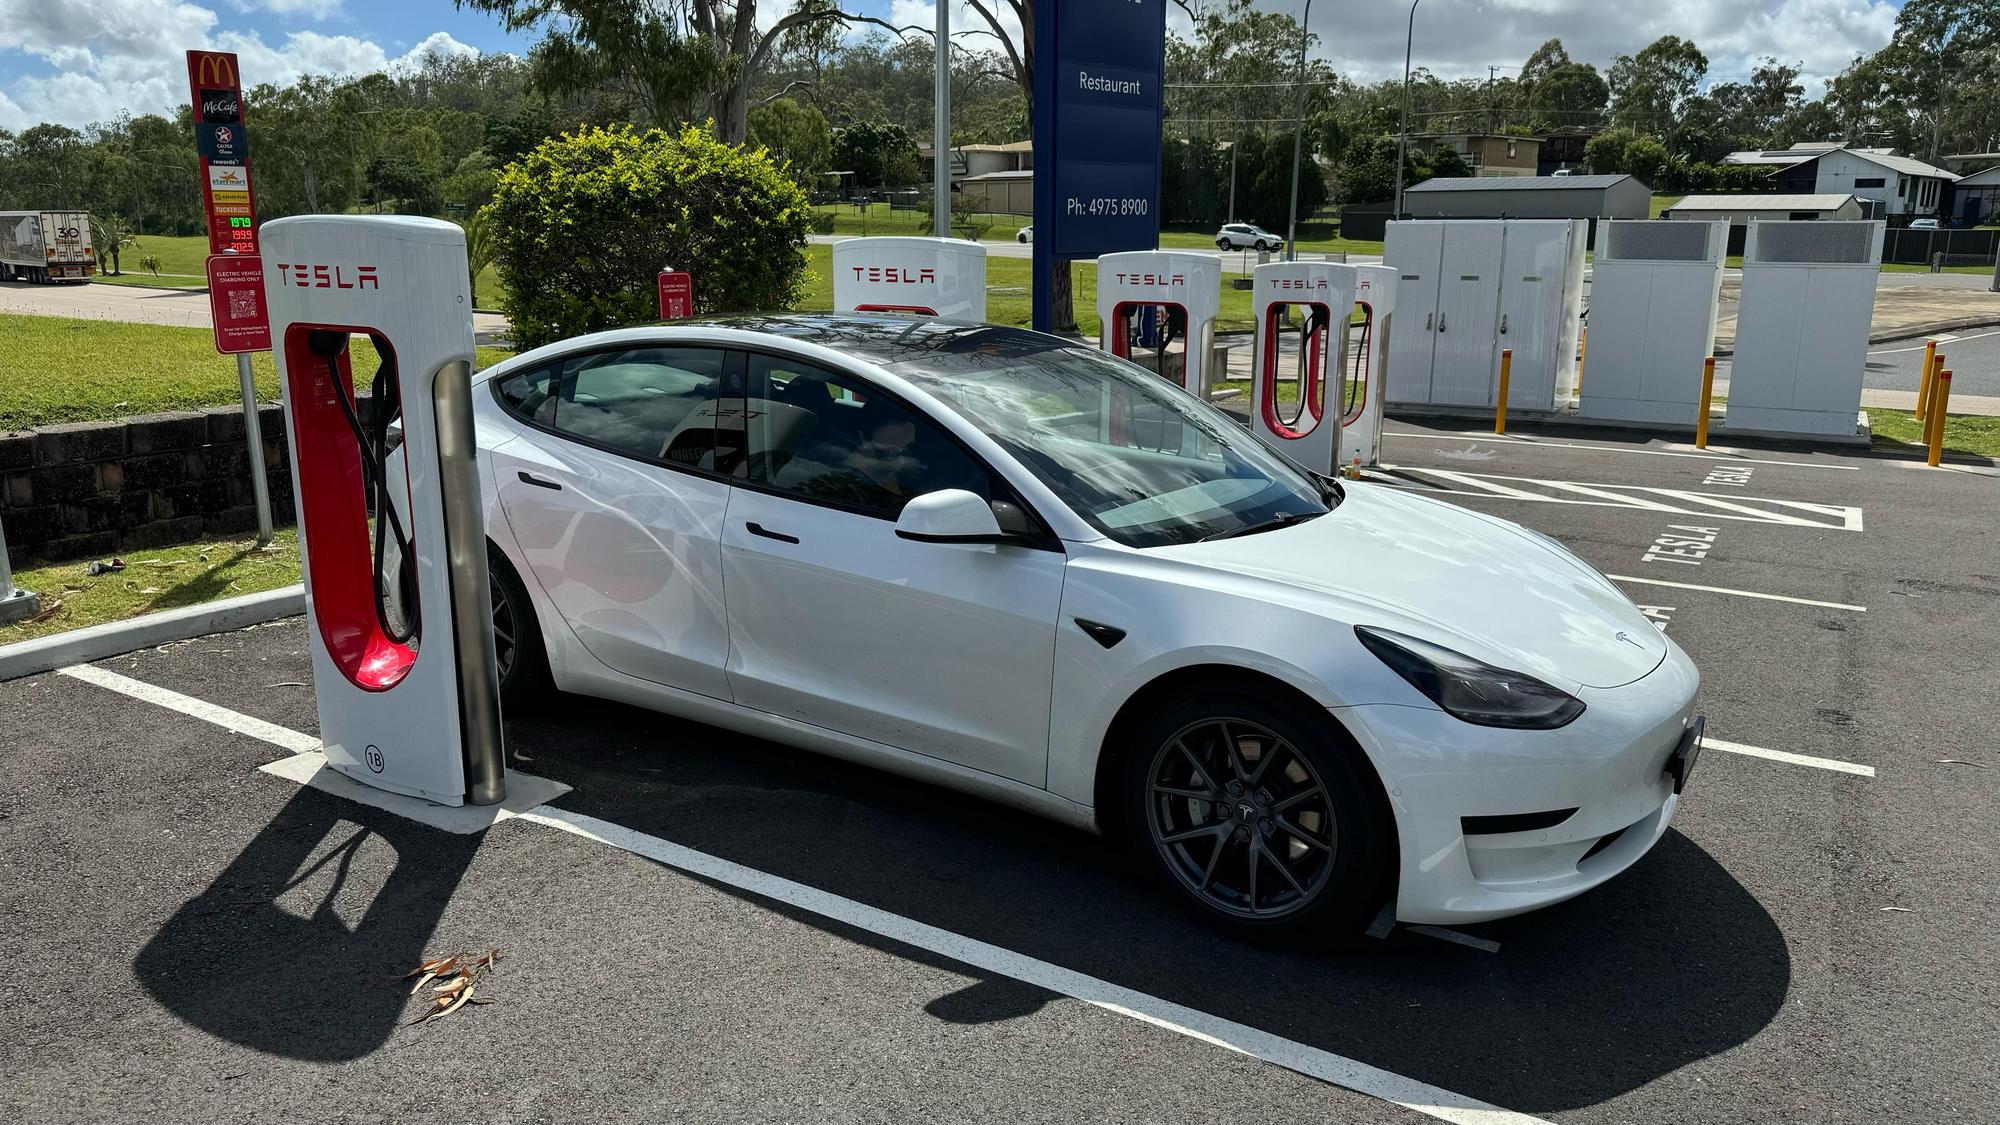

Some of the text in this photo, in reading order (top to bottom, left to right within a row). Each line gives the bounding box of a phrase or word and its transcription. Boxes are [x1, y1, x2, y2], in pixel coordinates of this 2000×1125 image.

[1080, 71, 1141, 95] Restaurant
[1067, 198, 1148, 216] Ph: 4975 8900
[277, 263, 379, 290] TESLA
[852, 267, 935, 284] TESLA
[1116, 273, 1184, 286] TESLA
[1271, 279, 1328, 290] TESLA
[1702, 465, 1755, 487] TESLA
[1641, 524, 1721, 566] TESLA
[368, 751, 382, 767] 1B
